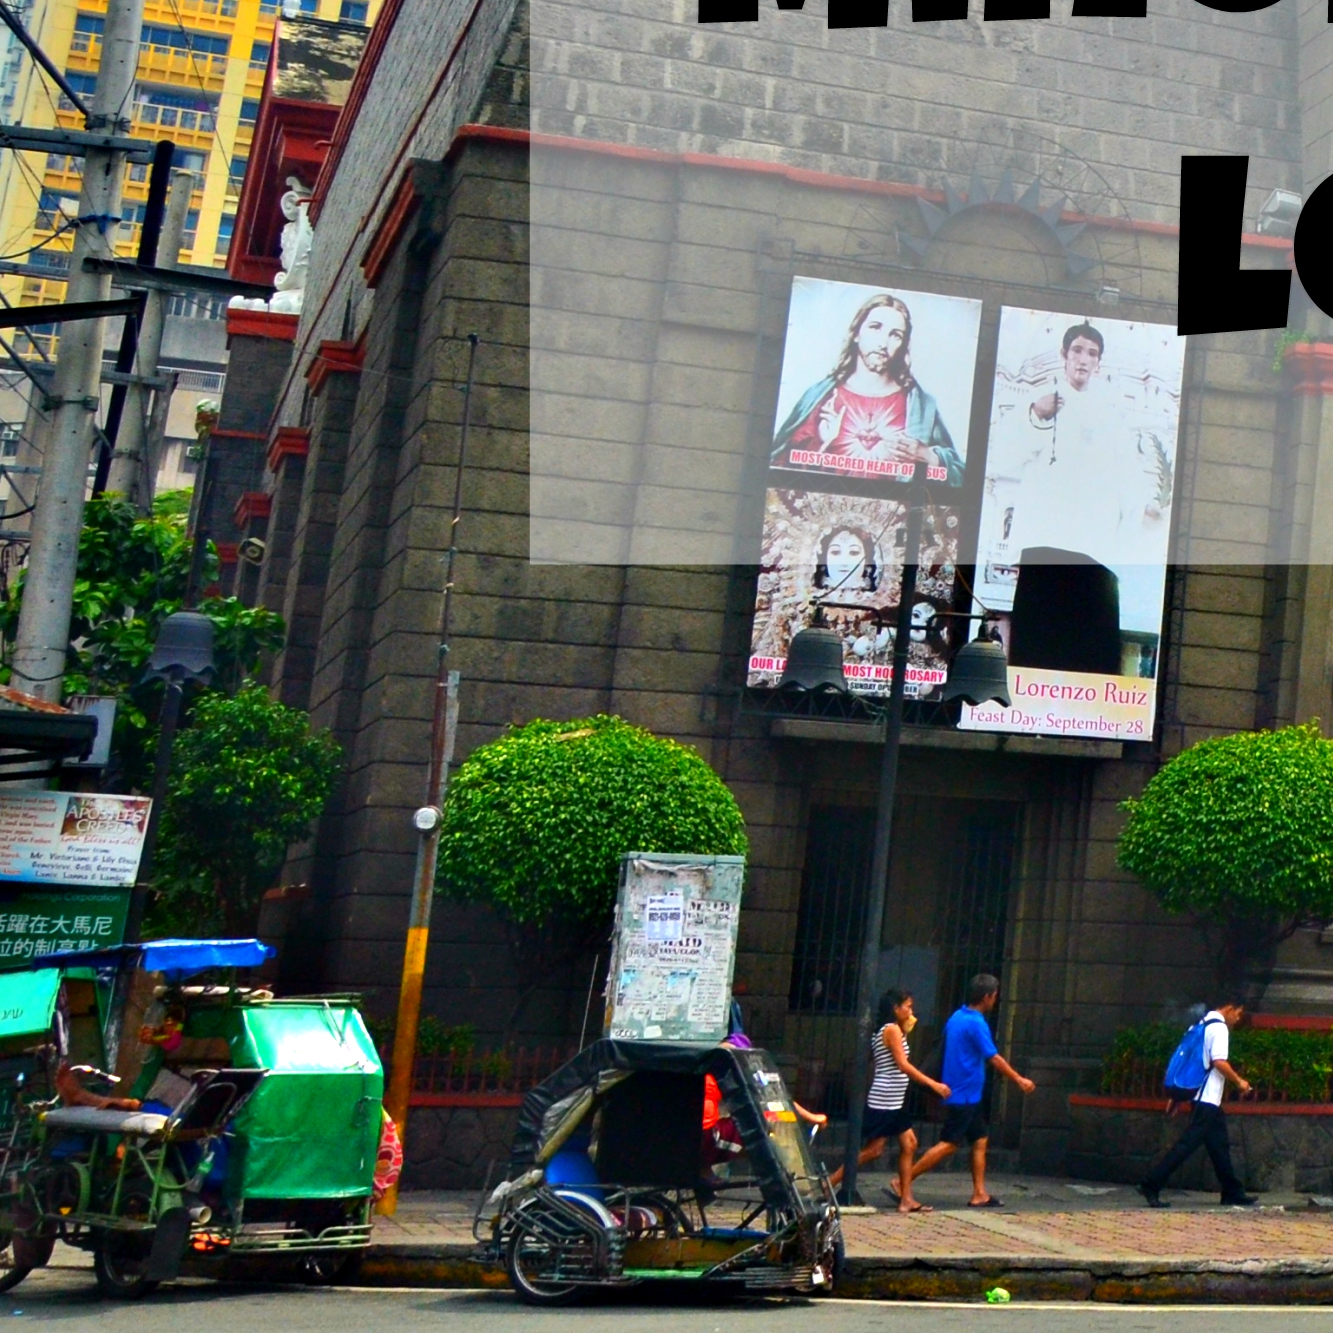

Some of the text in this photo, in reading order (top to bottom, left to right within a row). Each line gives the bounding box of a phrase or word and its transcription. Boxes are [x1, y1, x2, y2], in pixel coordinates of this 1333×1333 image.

[791, 451, 821, 465] MOST
[823, 454, 864, 470] SACRED
[867, 459, 899, 474] HEART
[901, 463, 914, 475] OF
[751, 657, 773, 670] OUR
[1015, 675, 1148, 706] Lorenzo Ruiz
[970, 708, 1143, 733] Feast Day: September 28
[76, 818, 127, 833] CREED
[64, 893, 121, 902] Corporation
